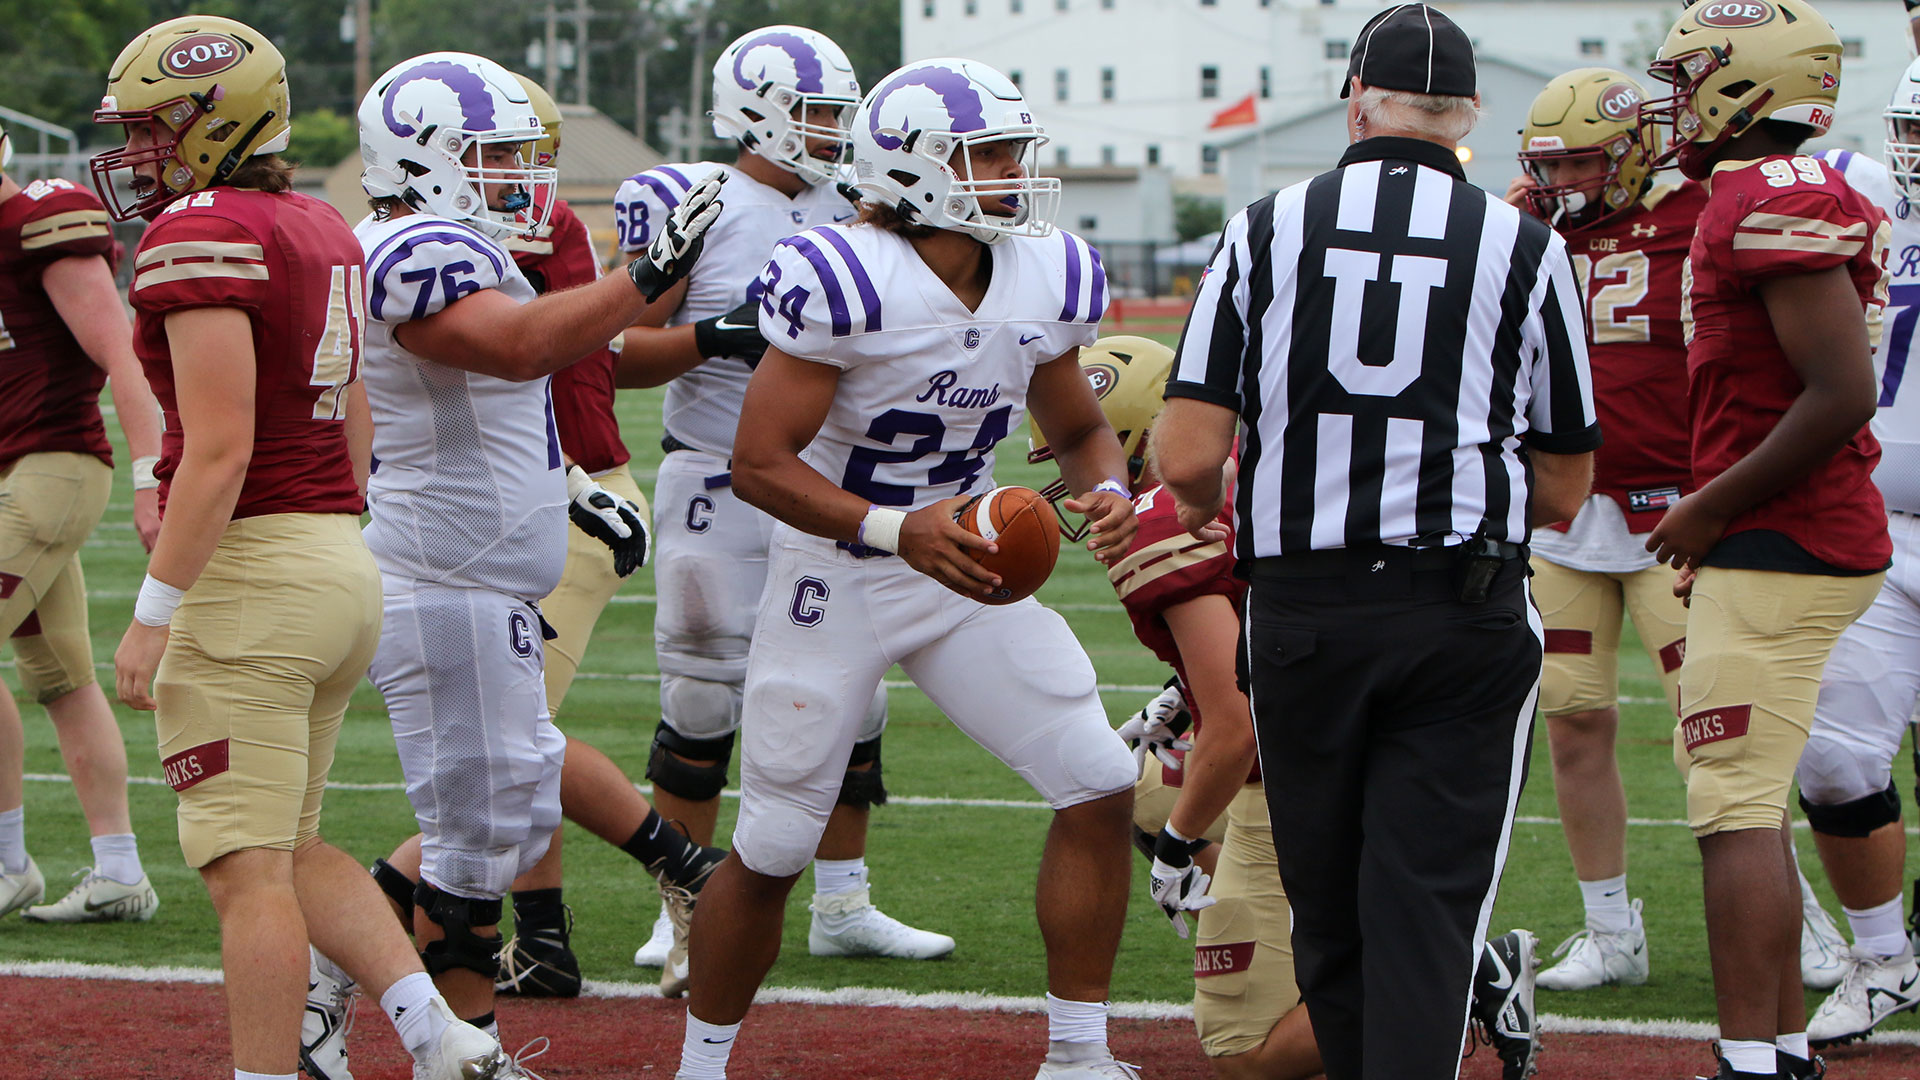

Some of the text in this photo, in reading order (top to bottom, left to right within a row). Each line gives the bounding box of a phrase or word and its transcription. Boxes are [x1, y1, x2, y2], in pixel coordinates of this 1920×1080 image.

[1704, 3, 1763, 19] COE
[170, 41, 233, 69] COE
[1020, 112, 1033, 124] E3
[1604, 87, 1640, 115] COE
[1759, 156, 1827, 188] 99
[614, 200, 650, 246] 68
[1589, 238, 1619, 252] COE
[400, 260, 481, 320] 76
[759, 259, 811, 340] 24
[1571, 249, 1650, 344] 2
[309, 264, 366, 420] 41
[963, 328, 980, 349] C
[1322, 247, 1449, 397] U
[915, 369, 1001, 409] Rams
[841, 404, 1013, 506] 24
[684, 493, 717, 535] C
[787, 575, 831, 628] C
[508, 610, 534, 658] C
[164, 754, 204, 787] AWKS
